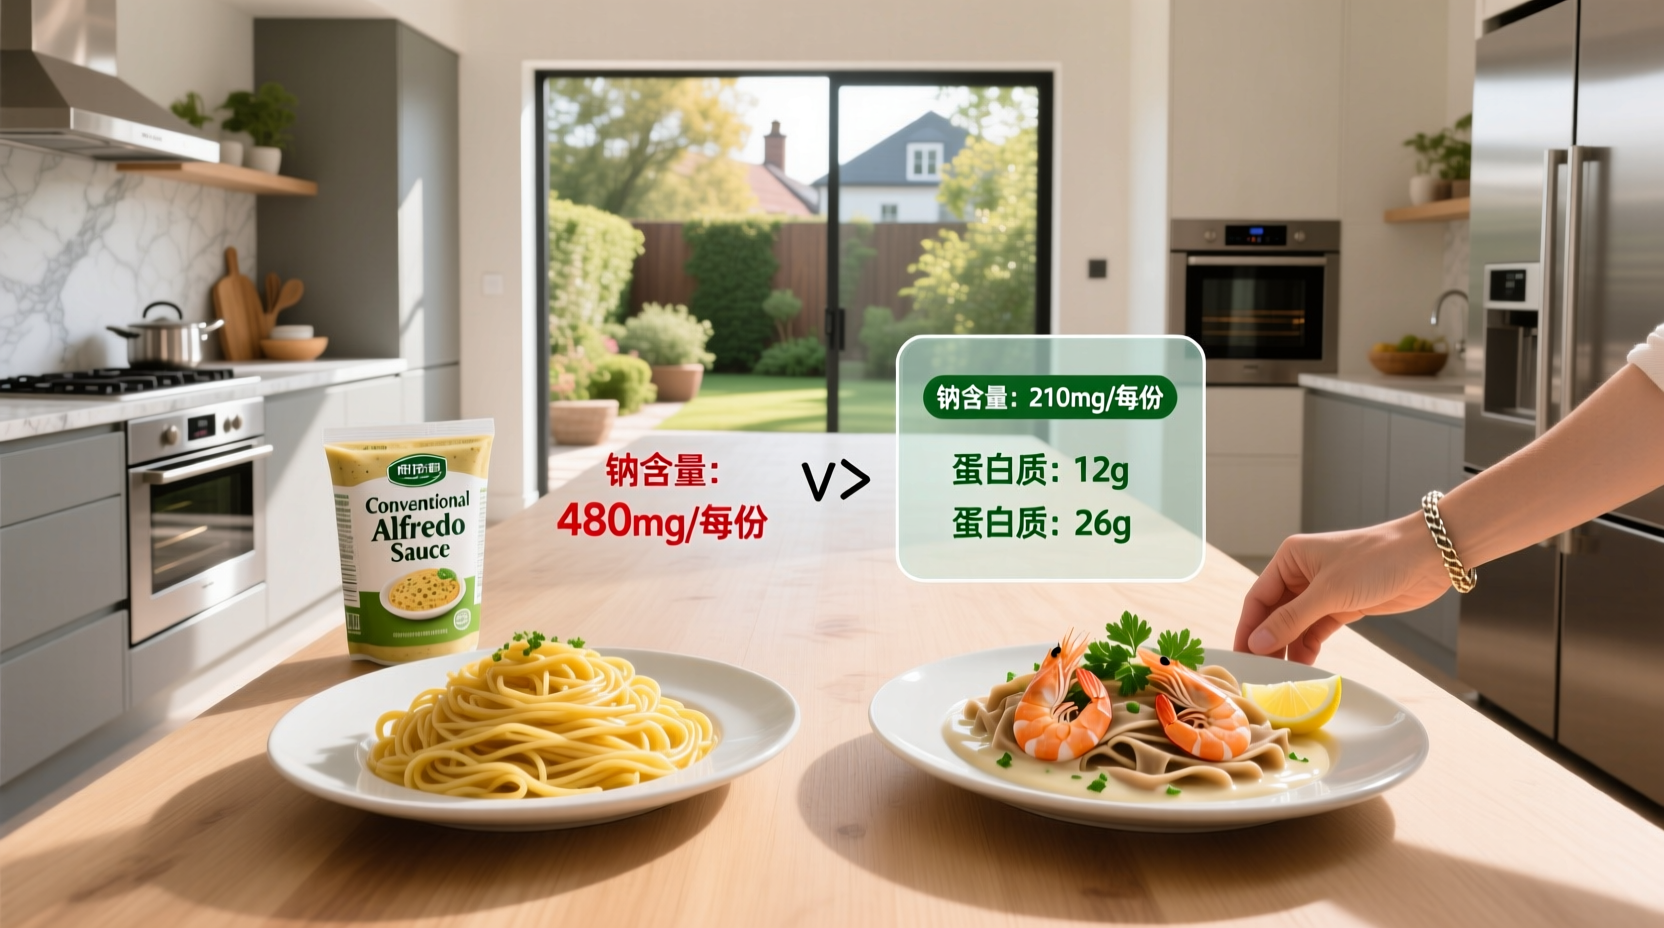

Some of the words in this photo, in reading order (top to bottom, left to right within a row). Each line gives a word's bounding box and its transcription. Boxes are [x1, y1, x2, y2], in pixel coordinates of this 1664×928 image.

[365, 490, 470, 514] Conventional
[371, 512, 466, 542] Alfredo
[391, 542, 450, 563] Sauce
